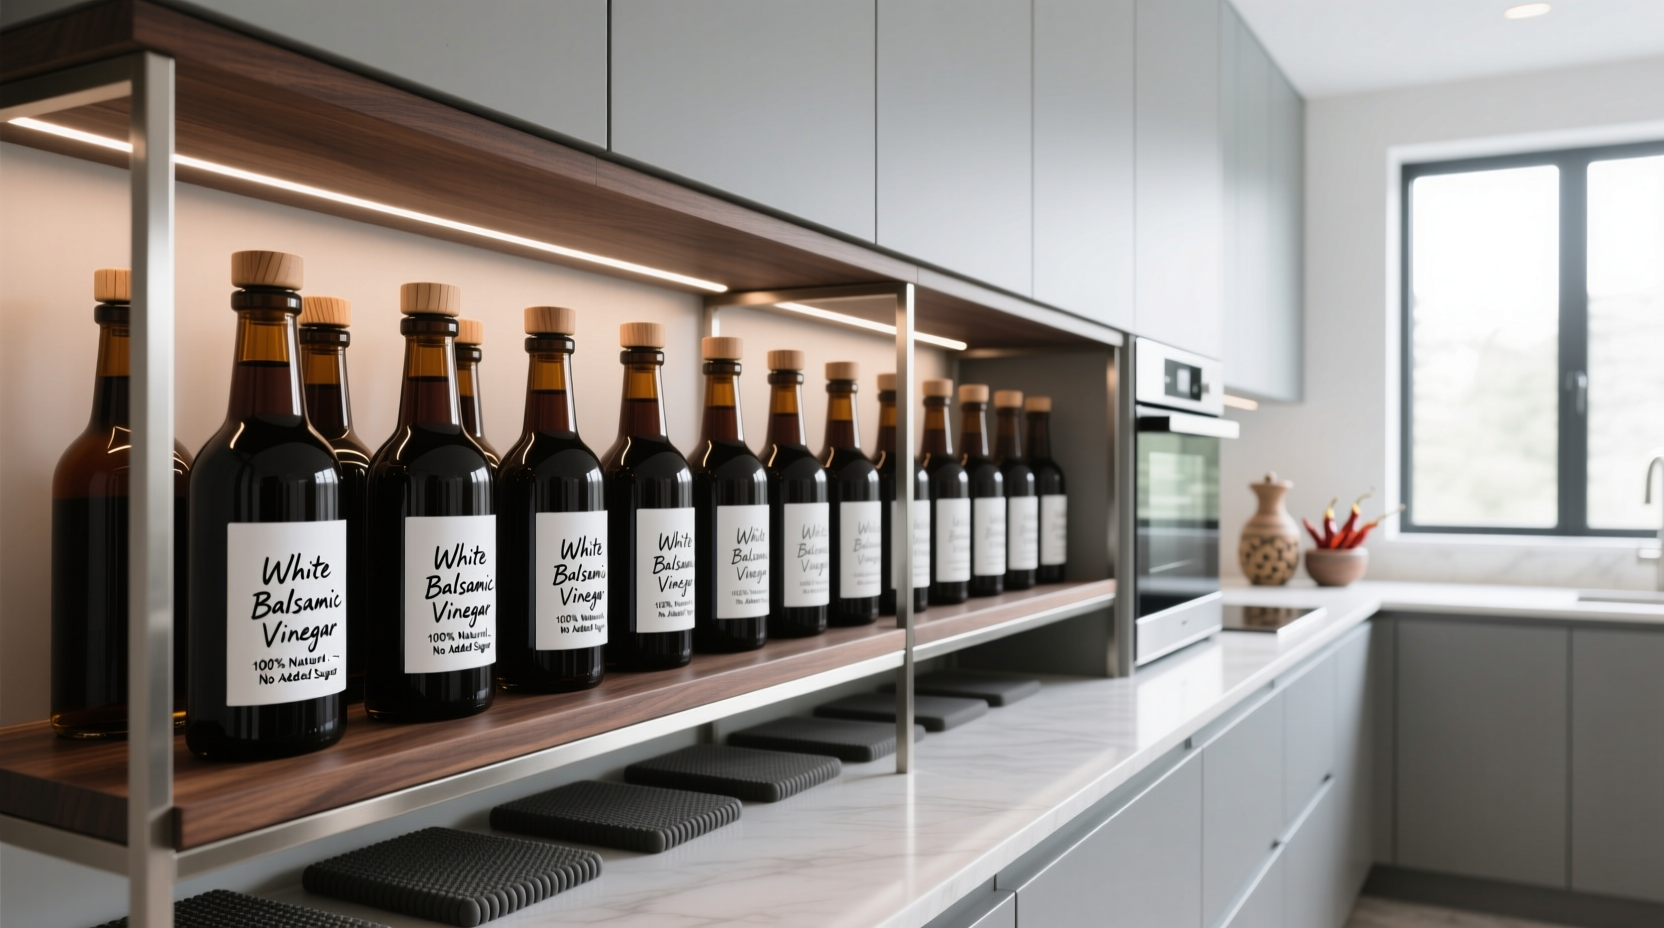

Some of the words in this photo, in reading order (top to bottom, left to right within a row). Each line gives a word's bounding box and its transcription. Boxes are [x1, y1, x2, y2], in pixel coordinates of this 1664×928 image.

[434, 542, 486, 570] White
[561, 535, 602, 560] White
[262, 552, 331, 585] White
[424, 572, 494, 600] Balsamic
[251, 588, 342, 619] Balsamic
[432, 600, 491, 628] Vinegar
[262, 620, 337, 653] Vinegar
[433, 645, 446, 656] No
[252, 657, 285, 671] 100%
[259, 672, 275, 685] No
